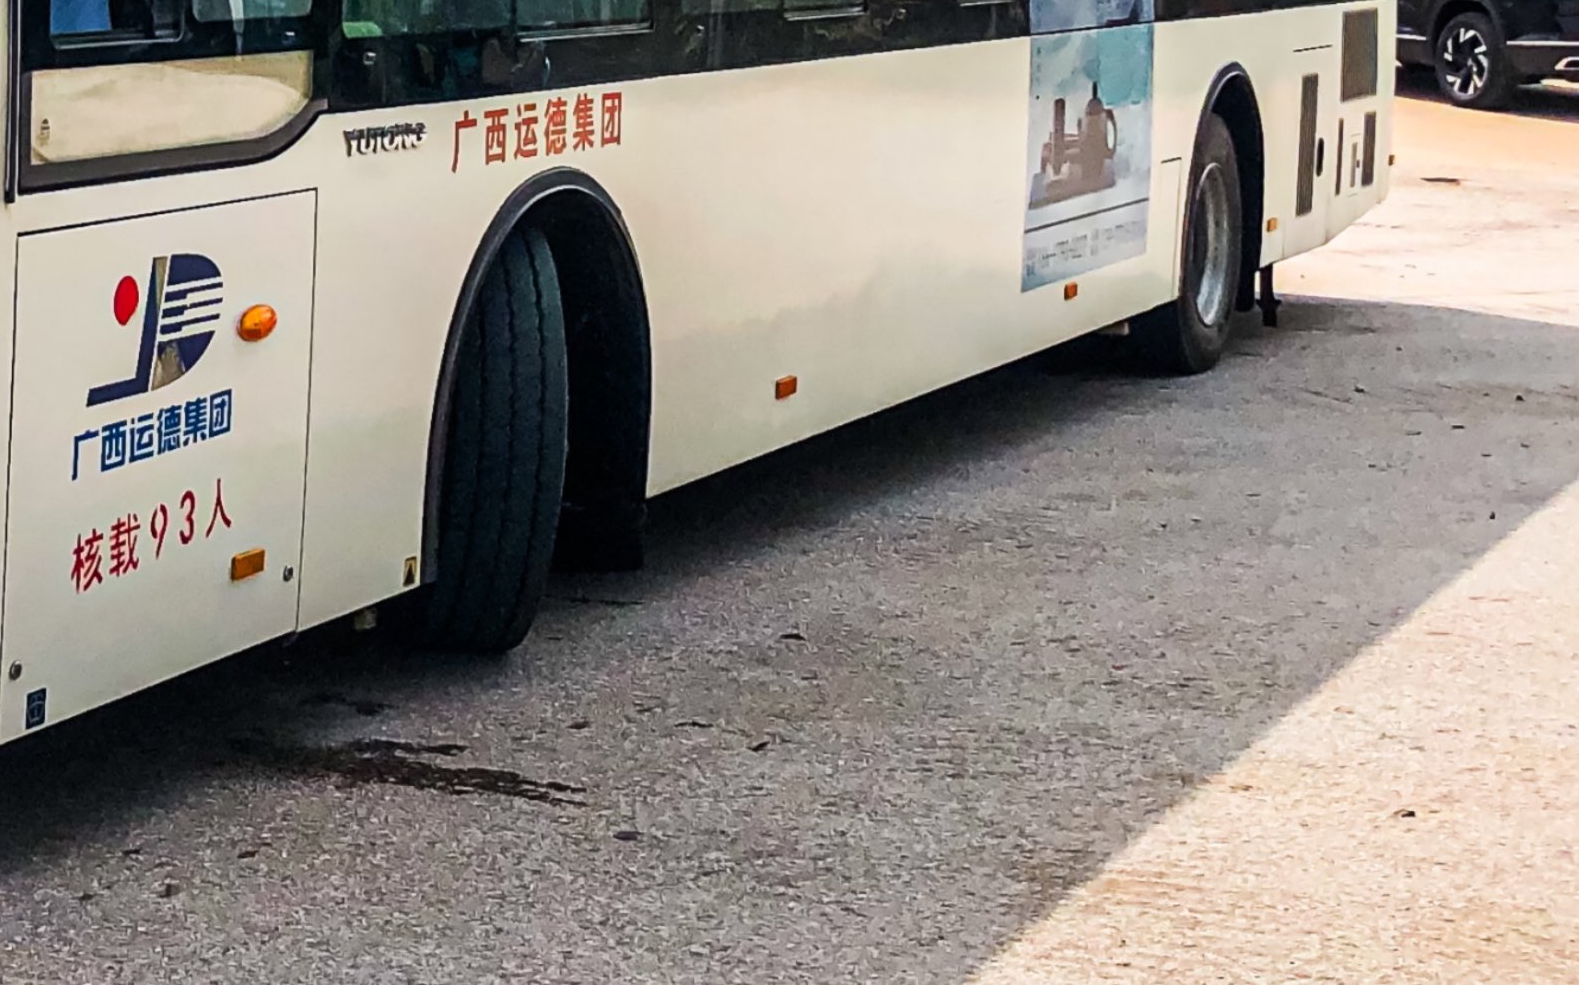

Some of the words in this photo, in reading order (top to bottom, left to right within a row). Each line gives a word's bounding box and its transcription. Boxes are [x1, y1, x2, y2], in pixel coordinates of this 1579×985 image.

[342, 122, 426, 157] YUTONG
[451, 92, 622, 173] 广西运德集团
[72, 388, 232, 482] 广西运德集团
[71, 478, 232, 594] 核载93人
